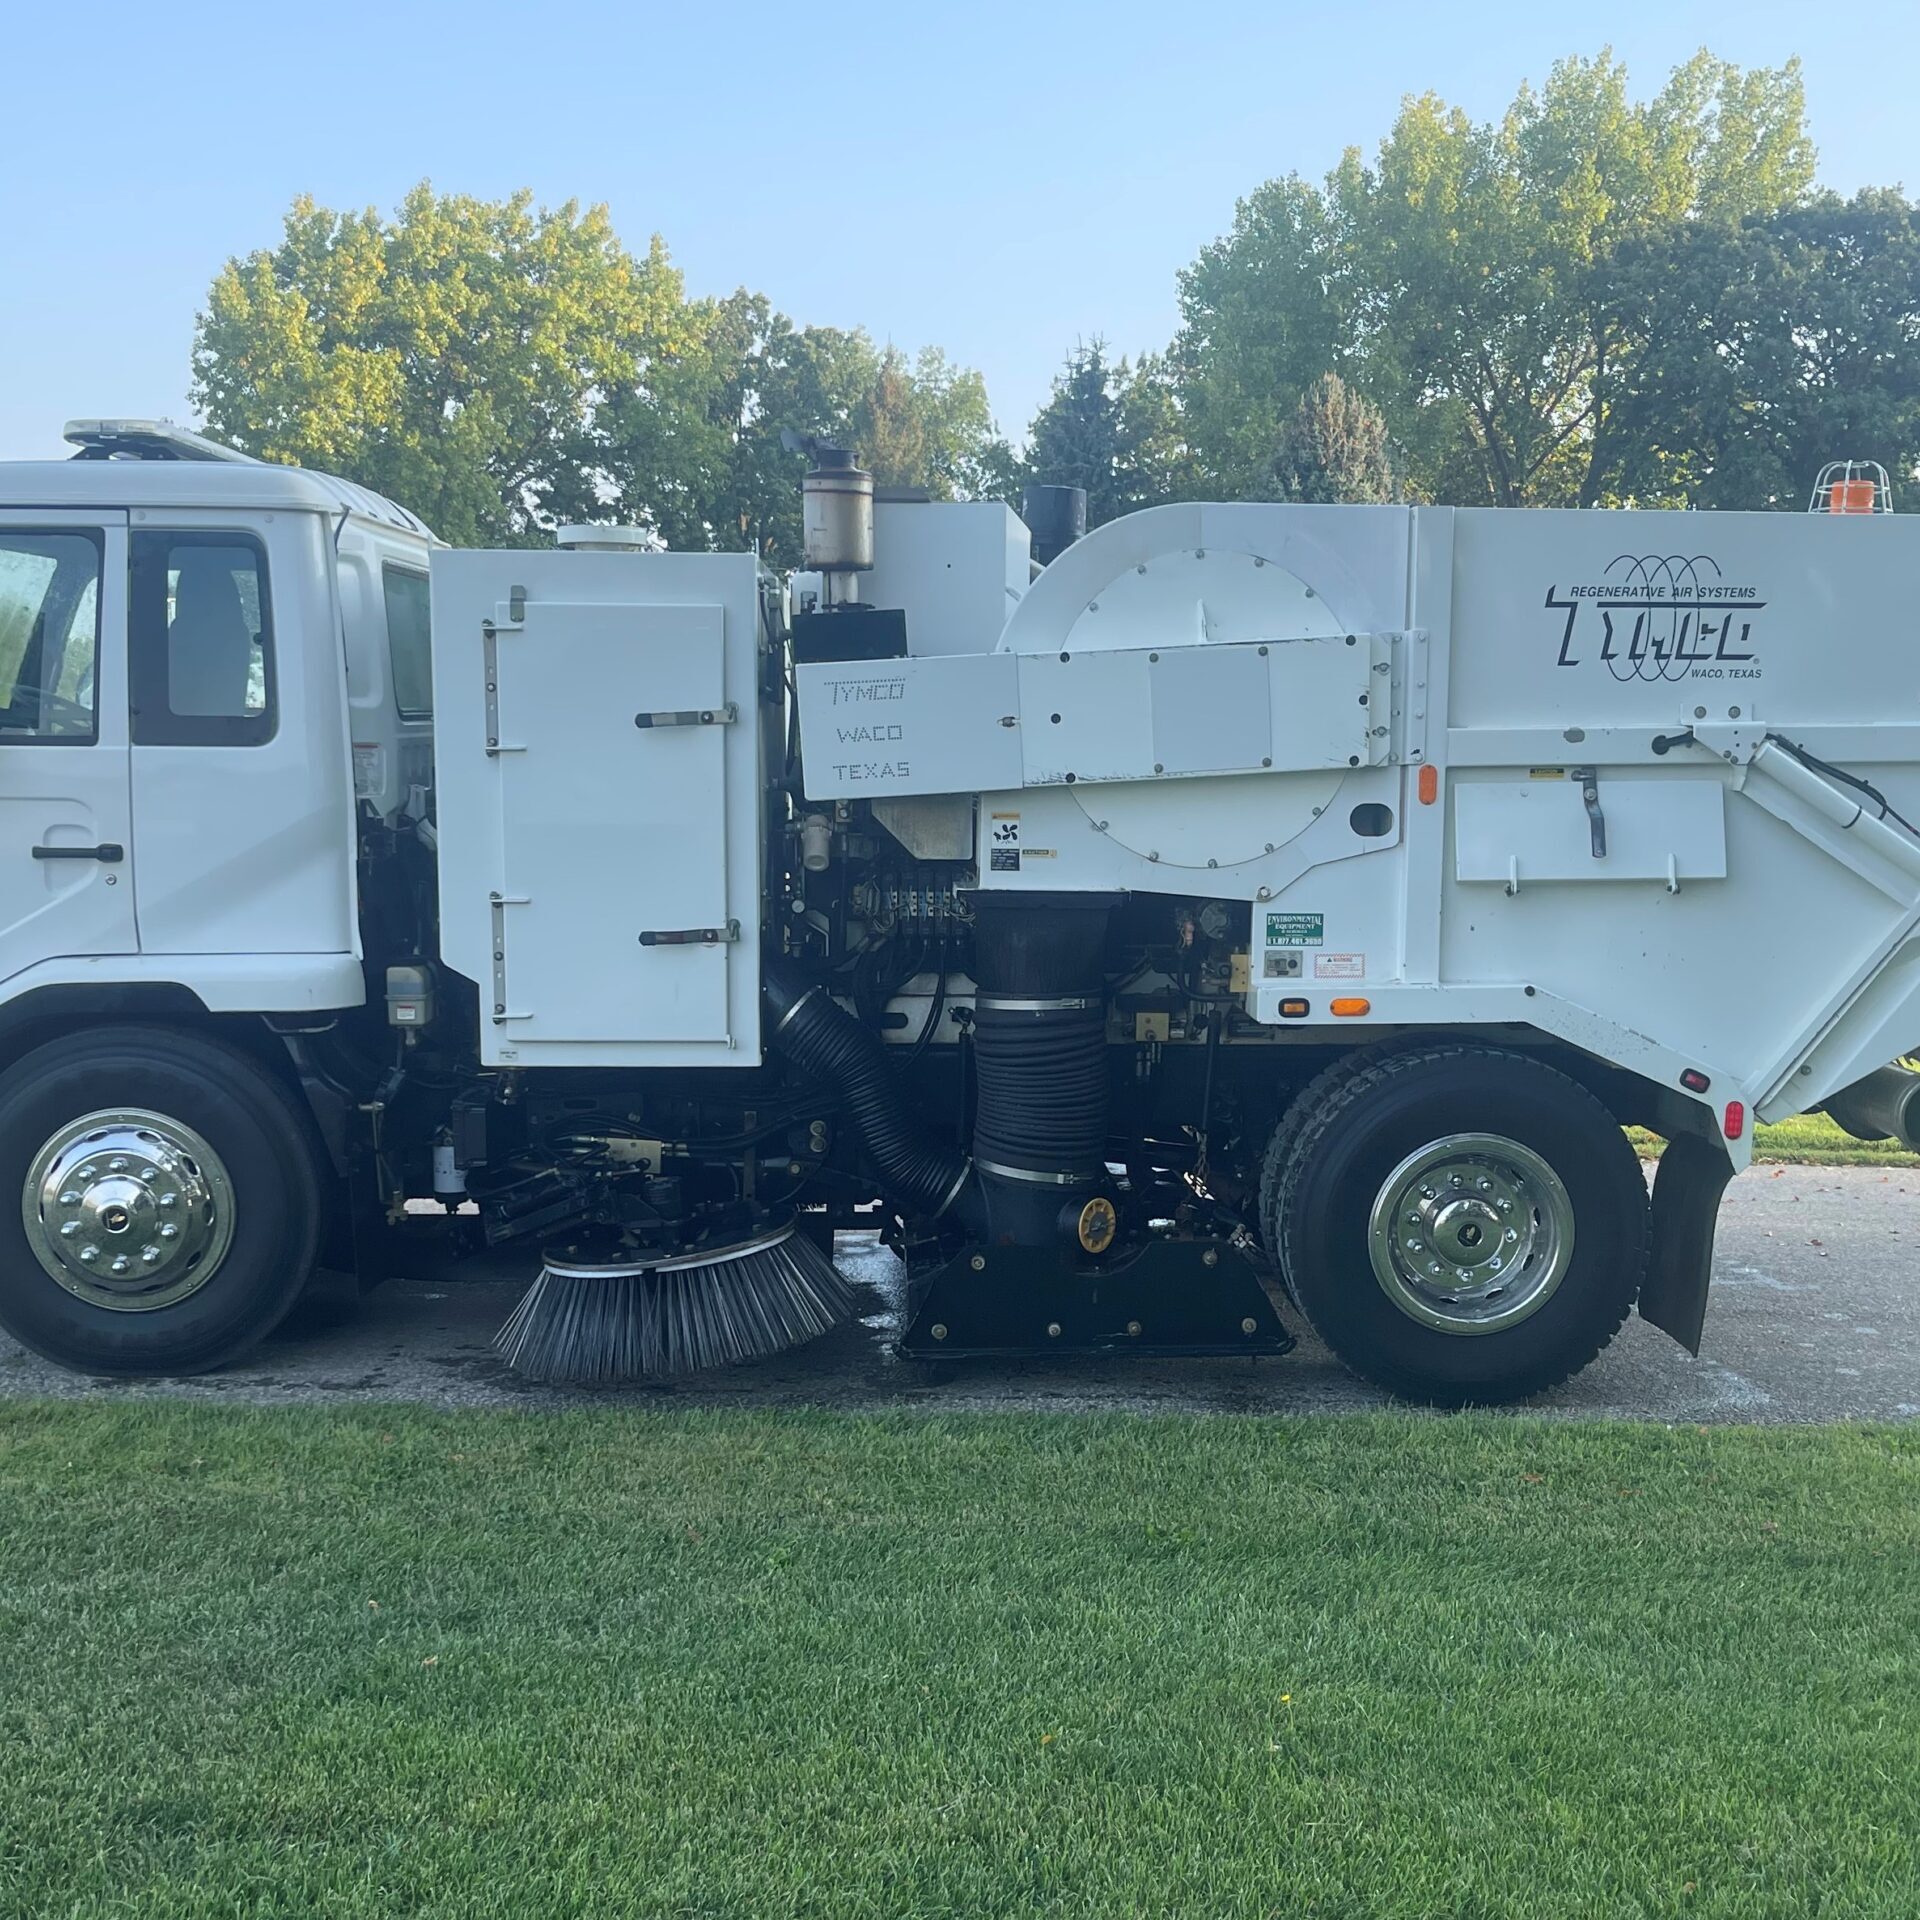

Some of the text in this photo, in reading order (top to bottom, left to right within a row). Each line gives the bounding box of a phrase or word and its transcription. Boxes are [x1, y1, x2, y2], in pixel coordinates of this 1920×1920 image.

[1570, 586, 1756, 598] REGENERATIVE AIR SYSTEMS
[1691, 669, 1762, 680] WACO, TEXAS
[823, 678, 906, 705] TYMCO
[836, 725, 903, 743] WACO
[832, 761, 910, 780] TEXAS
[1267, 915, 1322, 926] ENVIRONMENTAL
